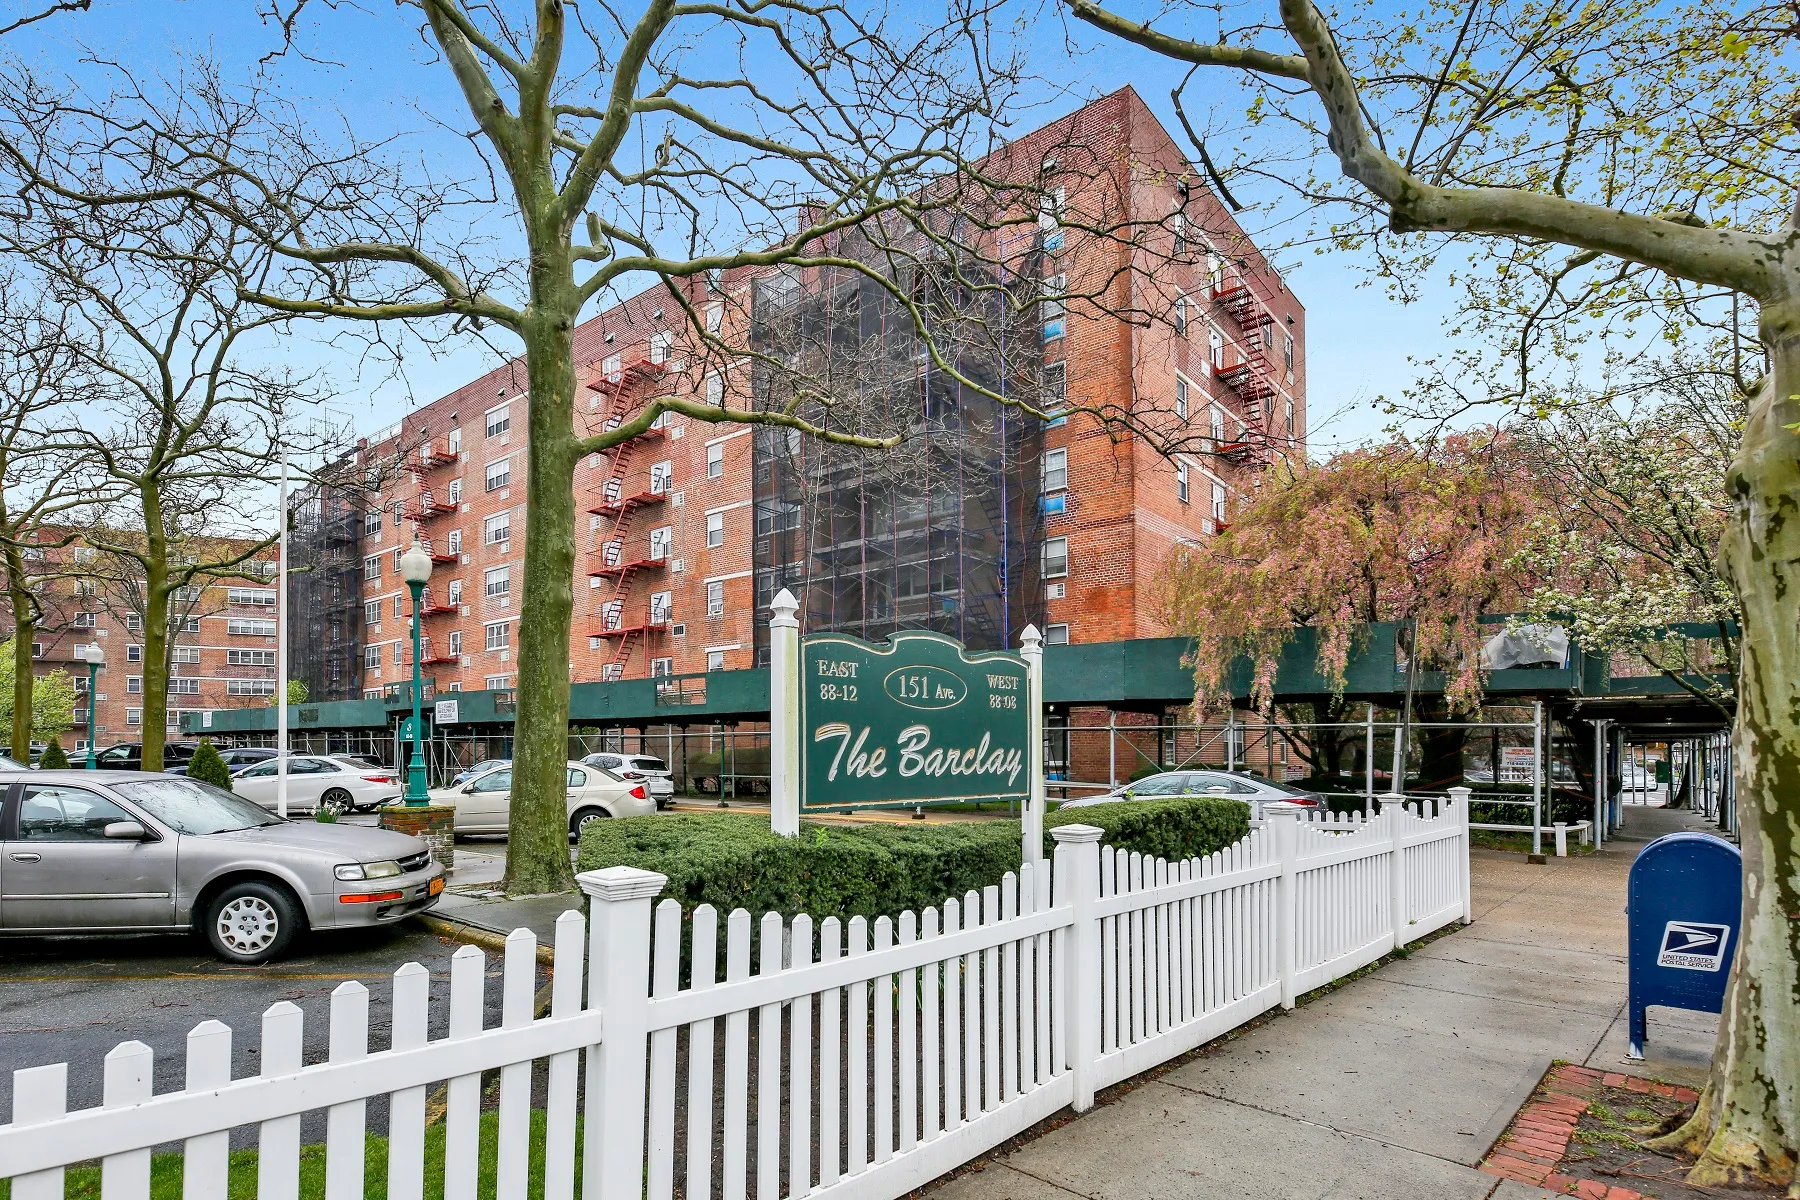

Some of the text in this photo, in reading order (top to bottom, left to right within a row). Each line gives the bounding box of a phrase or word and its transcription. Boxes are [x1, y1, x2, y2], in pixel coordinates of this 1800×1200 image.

[817, 659, 859, 678] EAST
[899, 674, 956, 700] 151 Ave.
[985, 673, 1019, 690] WEST
[820, 683, 858, 701] 88-12
[989, 693, 1017, 710] 88-08
[815, 722, 1023, 787] The Barclay
[1662, 954, 1689, 962] UNITED
[1687, 961, 1716, 969] SERVICE
